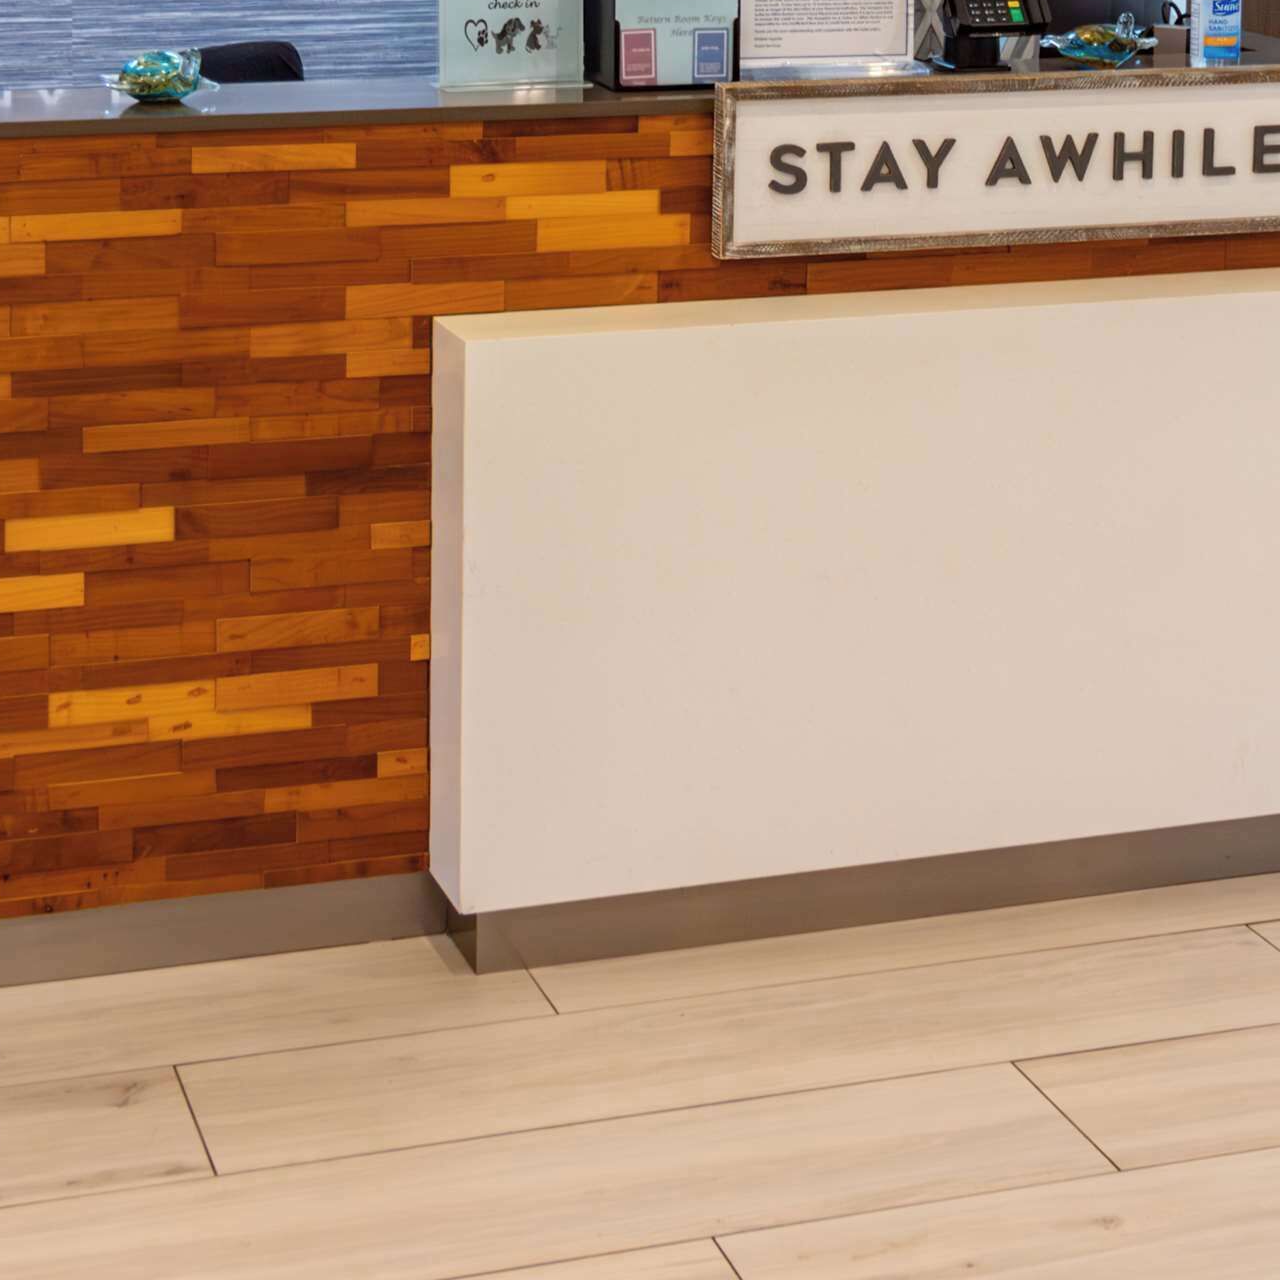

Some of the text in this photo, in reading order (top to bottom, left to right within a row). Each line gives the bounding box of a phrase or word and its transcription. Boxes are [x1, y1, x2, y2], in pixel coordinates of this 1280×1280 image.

[524, 0, 541, 9] in
[637, 15, 671, 24] Return
[674, 15, 700, 24] Room
[768, 137, 956, 195] STAY
